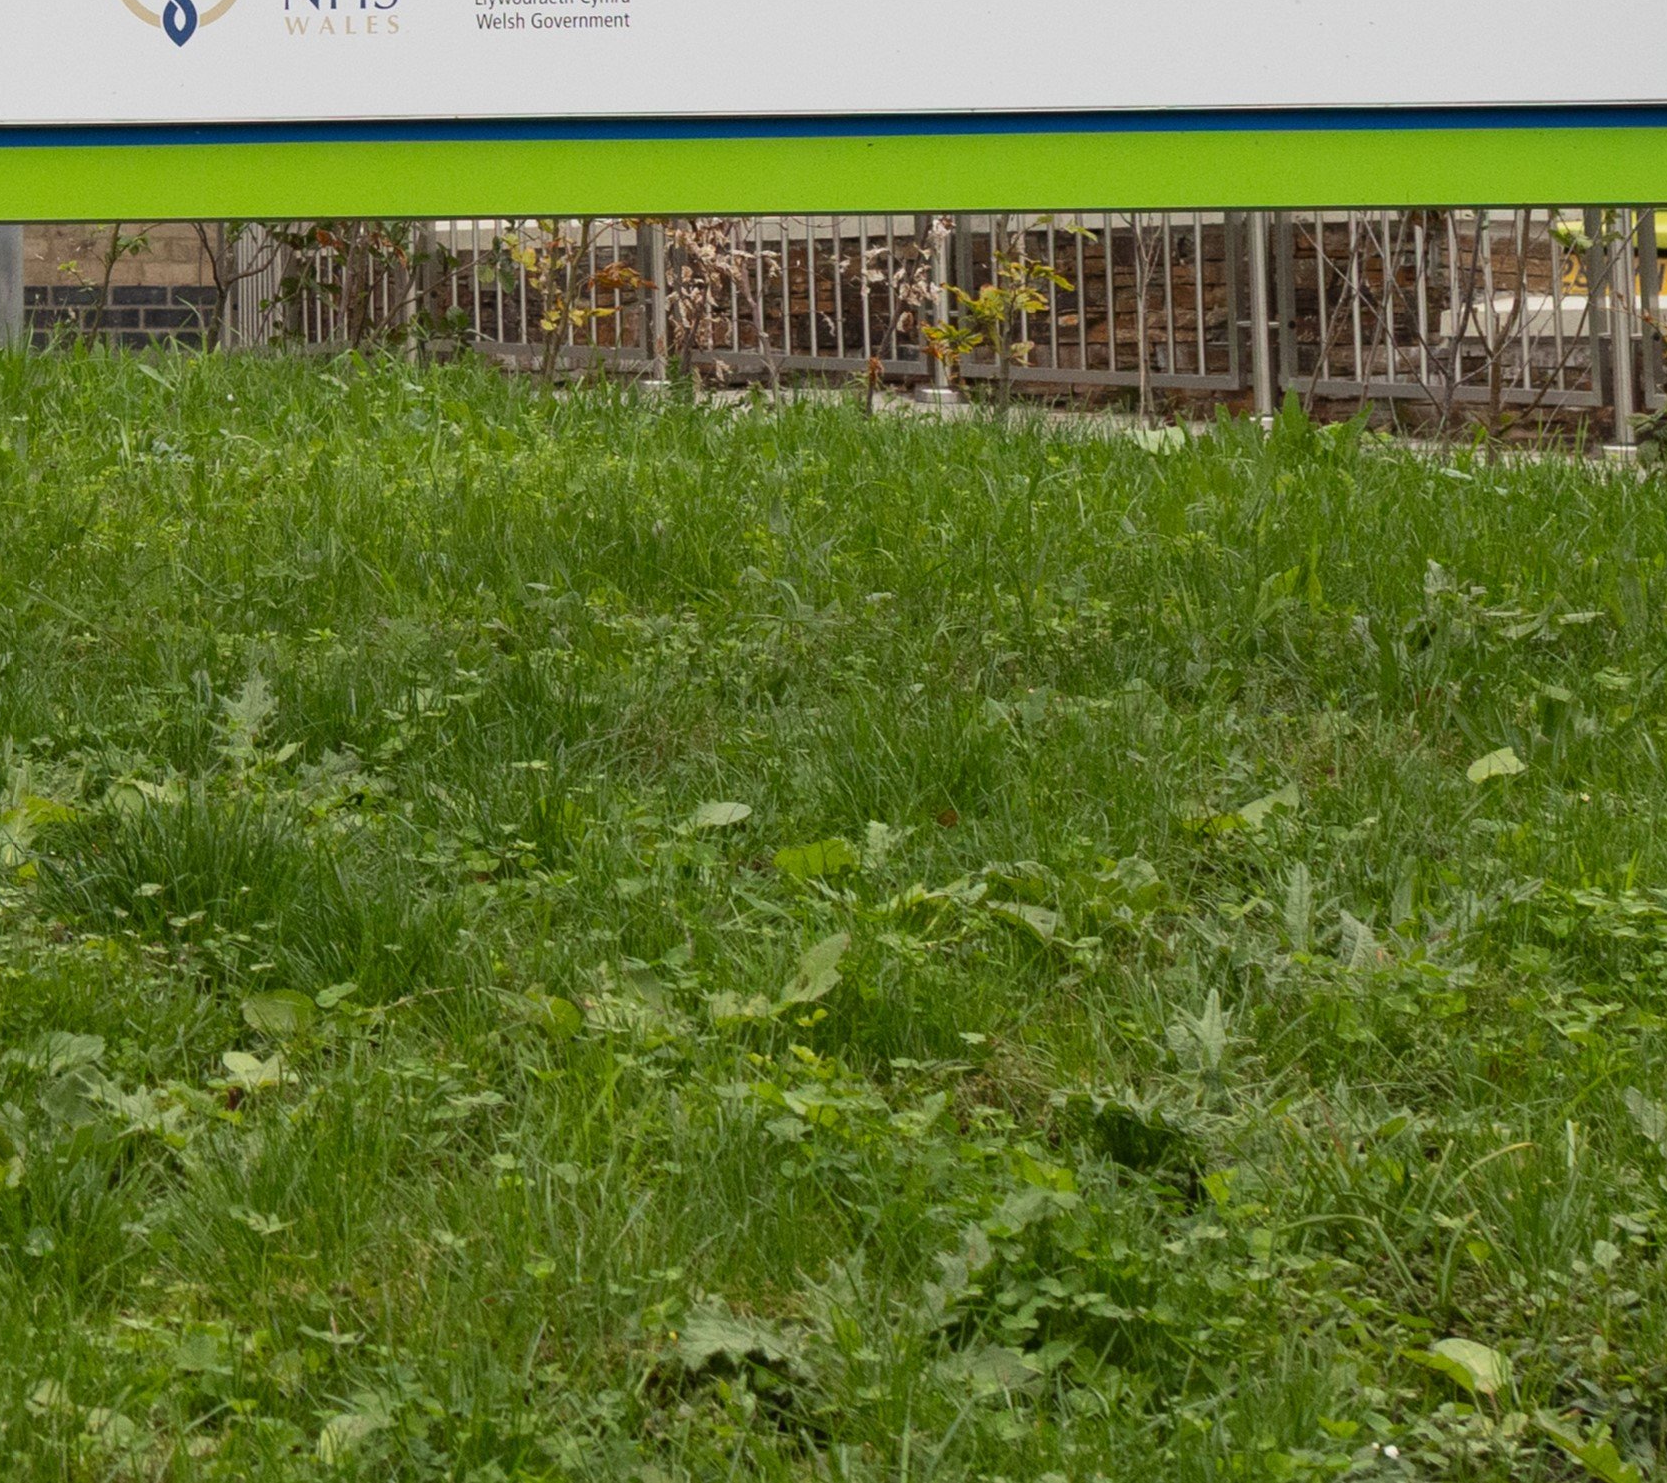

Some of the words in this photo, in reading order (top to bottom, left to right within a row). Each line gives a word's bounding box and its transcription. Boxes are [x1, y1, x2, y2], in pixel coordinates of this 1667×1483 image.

[284, 14, 400, 36] WALES
[475, 12, 526, 30] Welsh
[530, 10, 631, 30] Government
